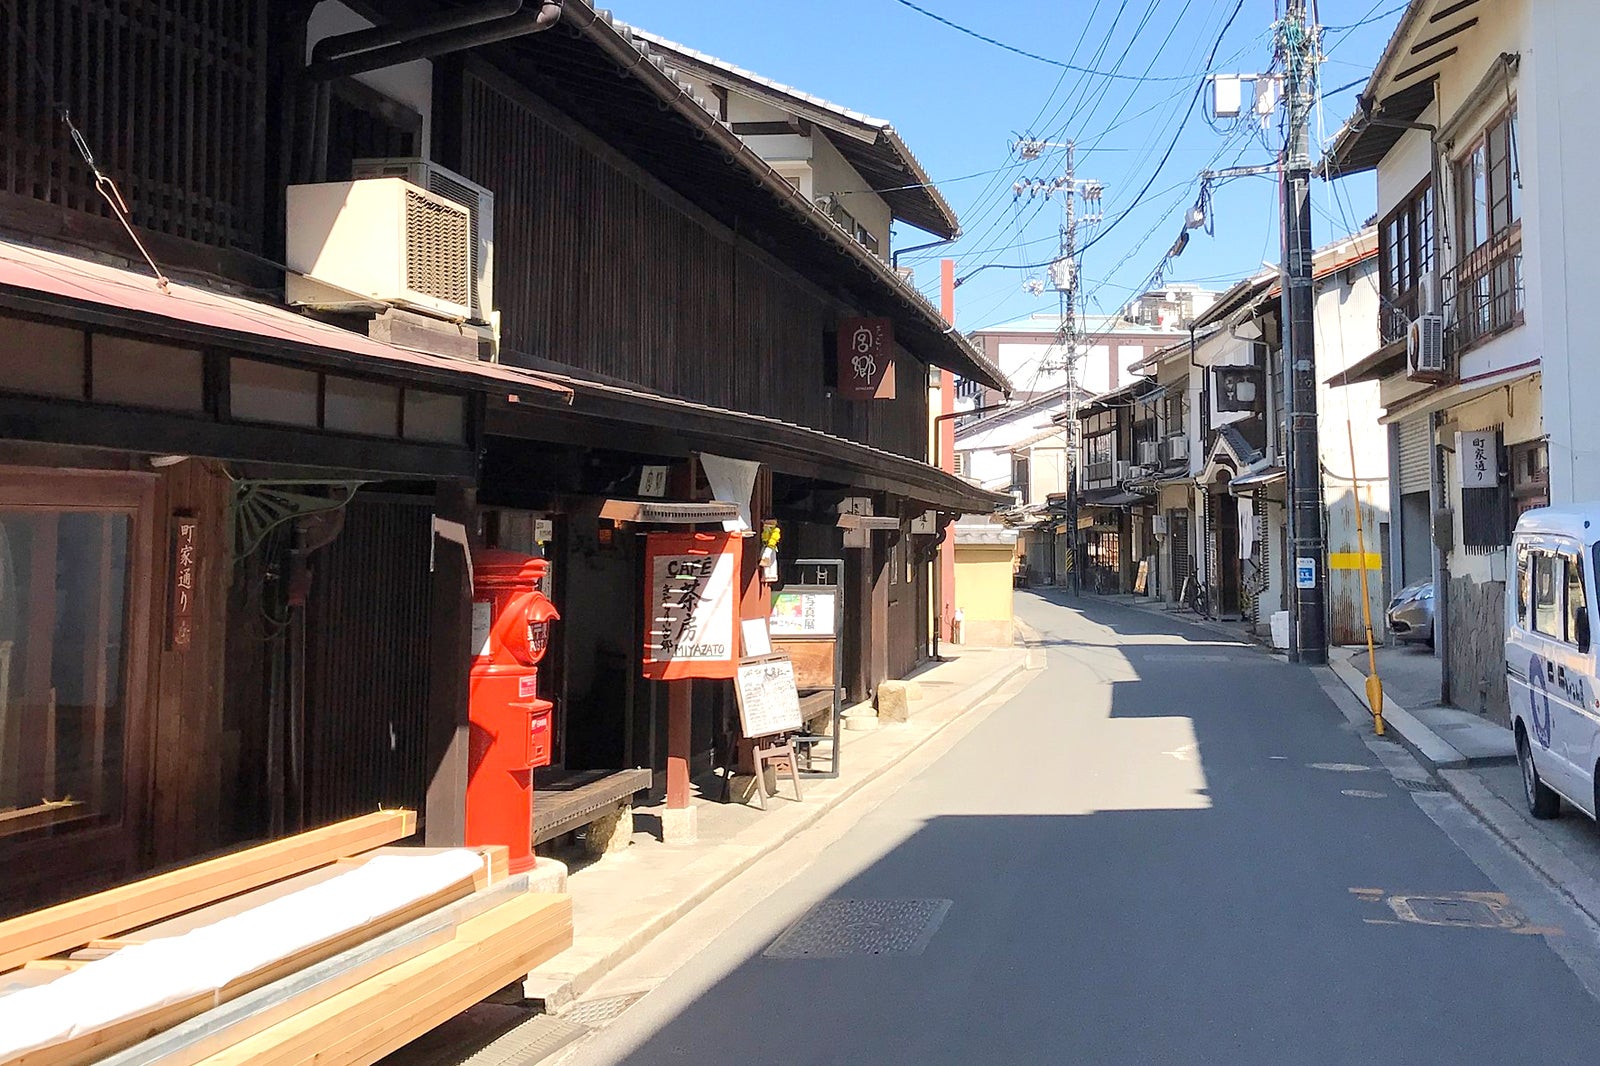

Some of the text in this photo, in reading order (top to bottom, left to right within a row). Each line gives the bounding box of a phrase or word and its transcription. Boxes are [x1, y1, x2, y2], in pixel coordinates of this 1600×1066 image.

[1472, 438, 1487, 481] 町家通り
[178, 524, 195, 612] 町家通り
[675, 579, 713, 642] 茶房
[675, 643, 725, 656] MIYAZATO
